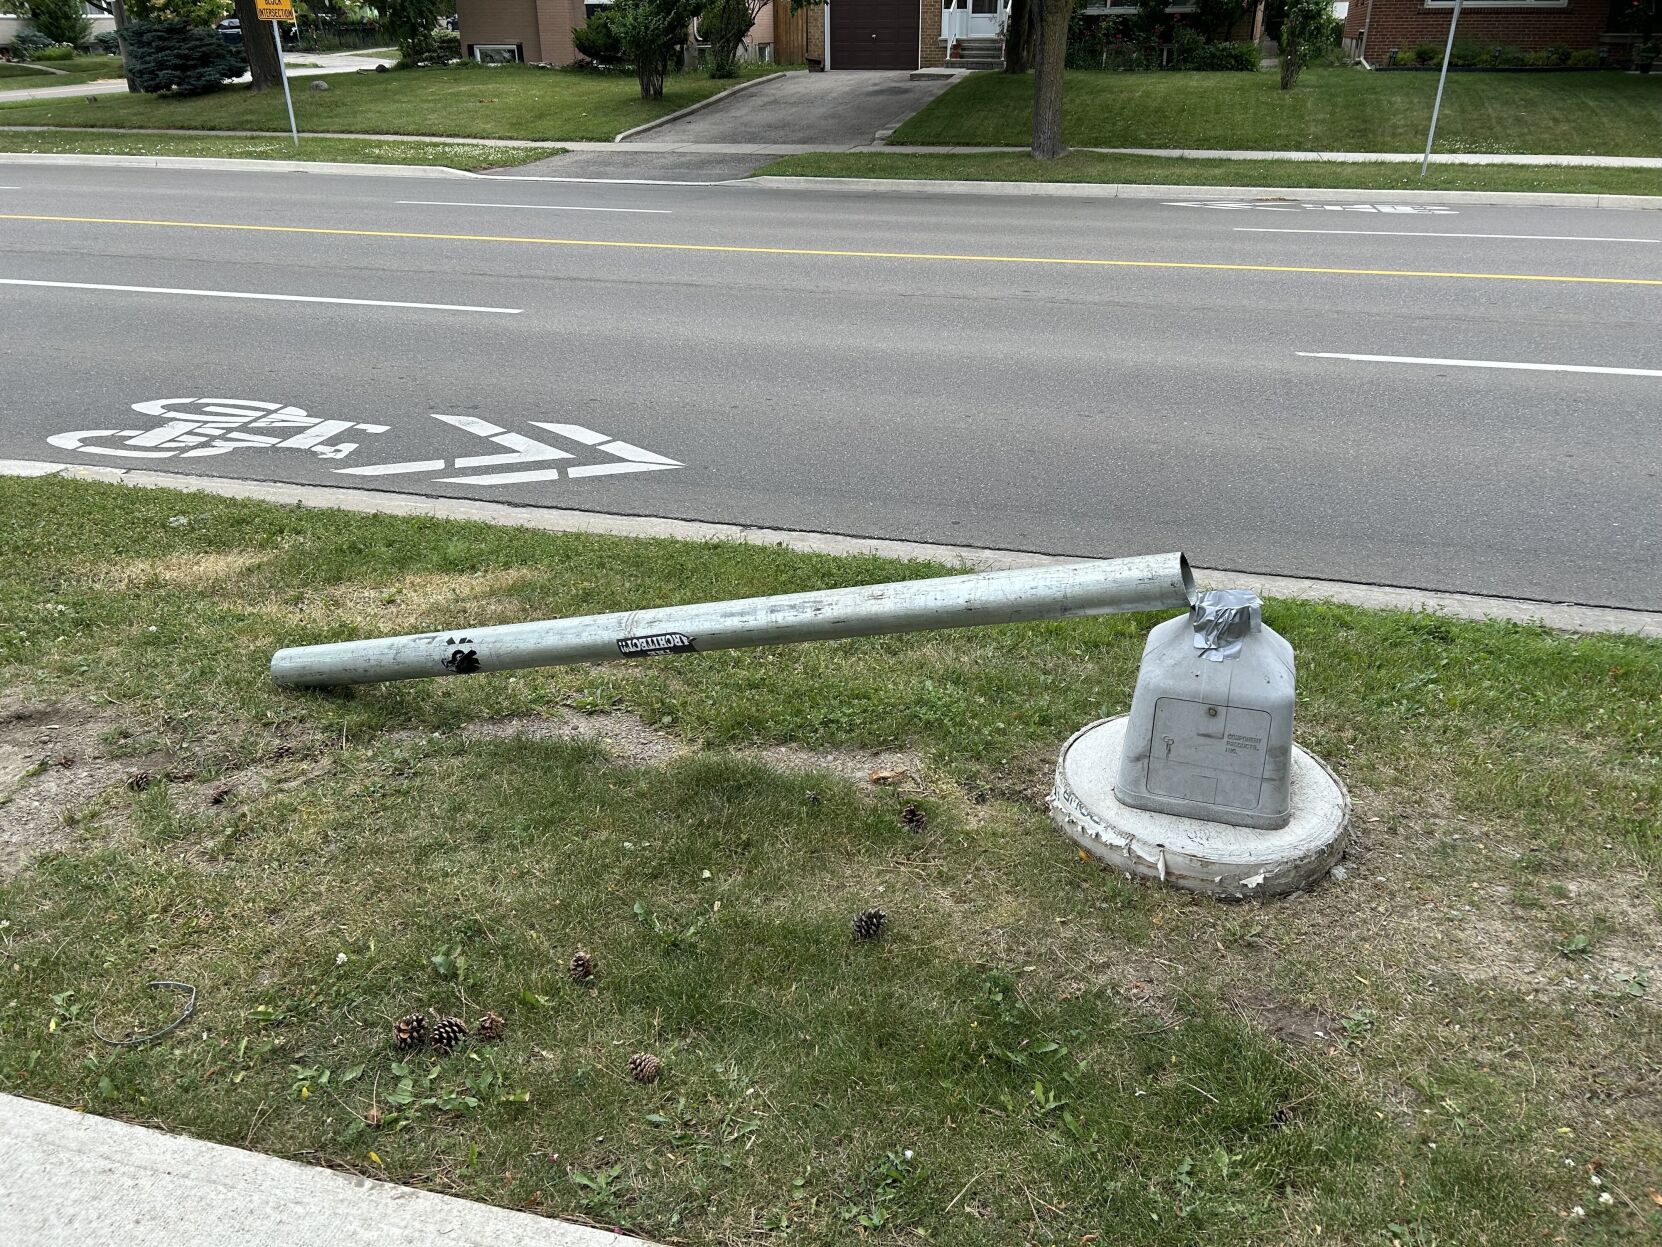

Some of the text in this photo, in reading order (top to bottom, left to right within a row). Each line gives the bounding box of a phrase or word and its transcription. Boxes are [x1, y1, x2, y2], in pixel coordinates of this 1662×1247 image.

[259, 8, 293, 18] INTERSECTION
[618, 634, 691, 653] ARCHITECT?!
[1227, 733, 1263, 744] COMPONENT
